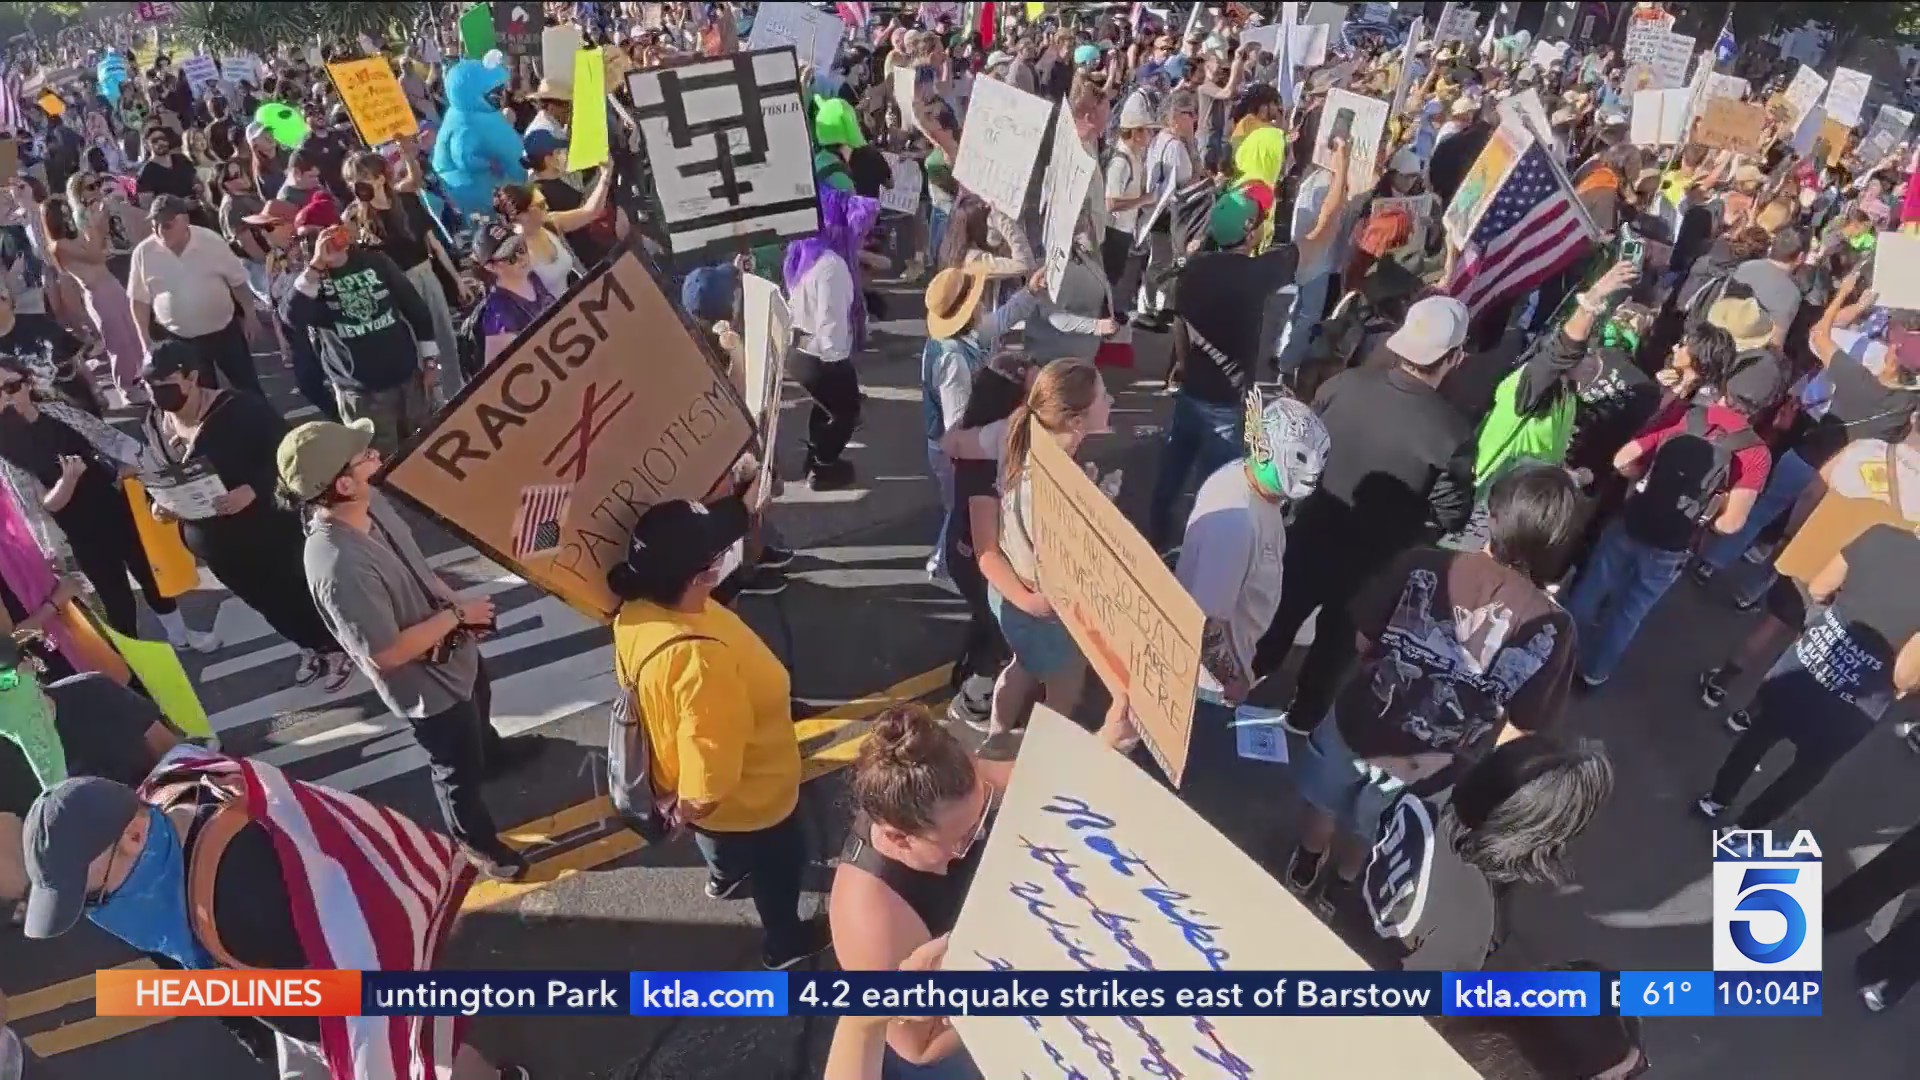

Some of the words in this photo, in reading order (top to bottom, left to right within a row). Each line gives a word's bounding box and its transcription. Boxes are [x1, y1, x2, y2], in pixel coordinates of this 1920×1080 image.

[423, 271, 636, 482] RACISM
[551, 379, 729, 583] PATRIOTISM
[1112, 566, 1132, 613] SO
[1128, 640, 1184, 734] HERE
[1821, 662, 1848, 688] THE
[1837, 645, 1863, 670] NOT
[1018, 833, 1087, 900] the
[1041, 795, 1163, 882] Not
[1138, 886, 1231, 972] like
